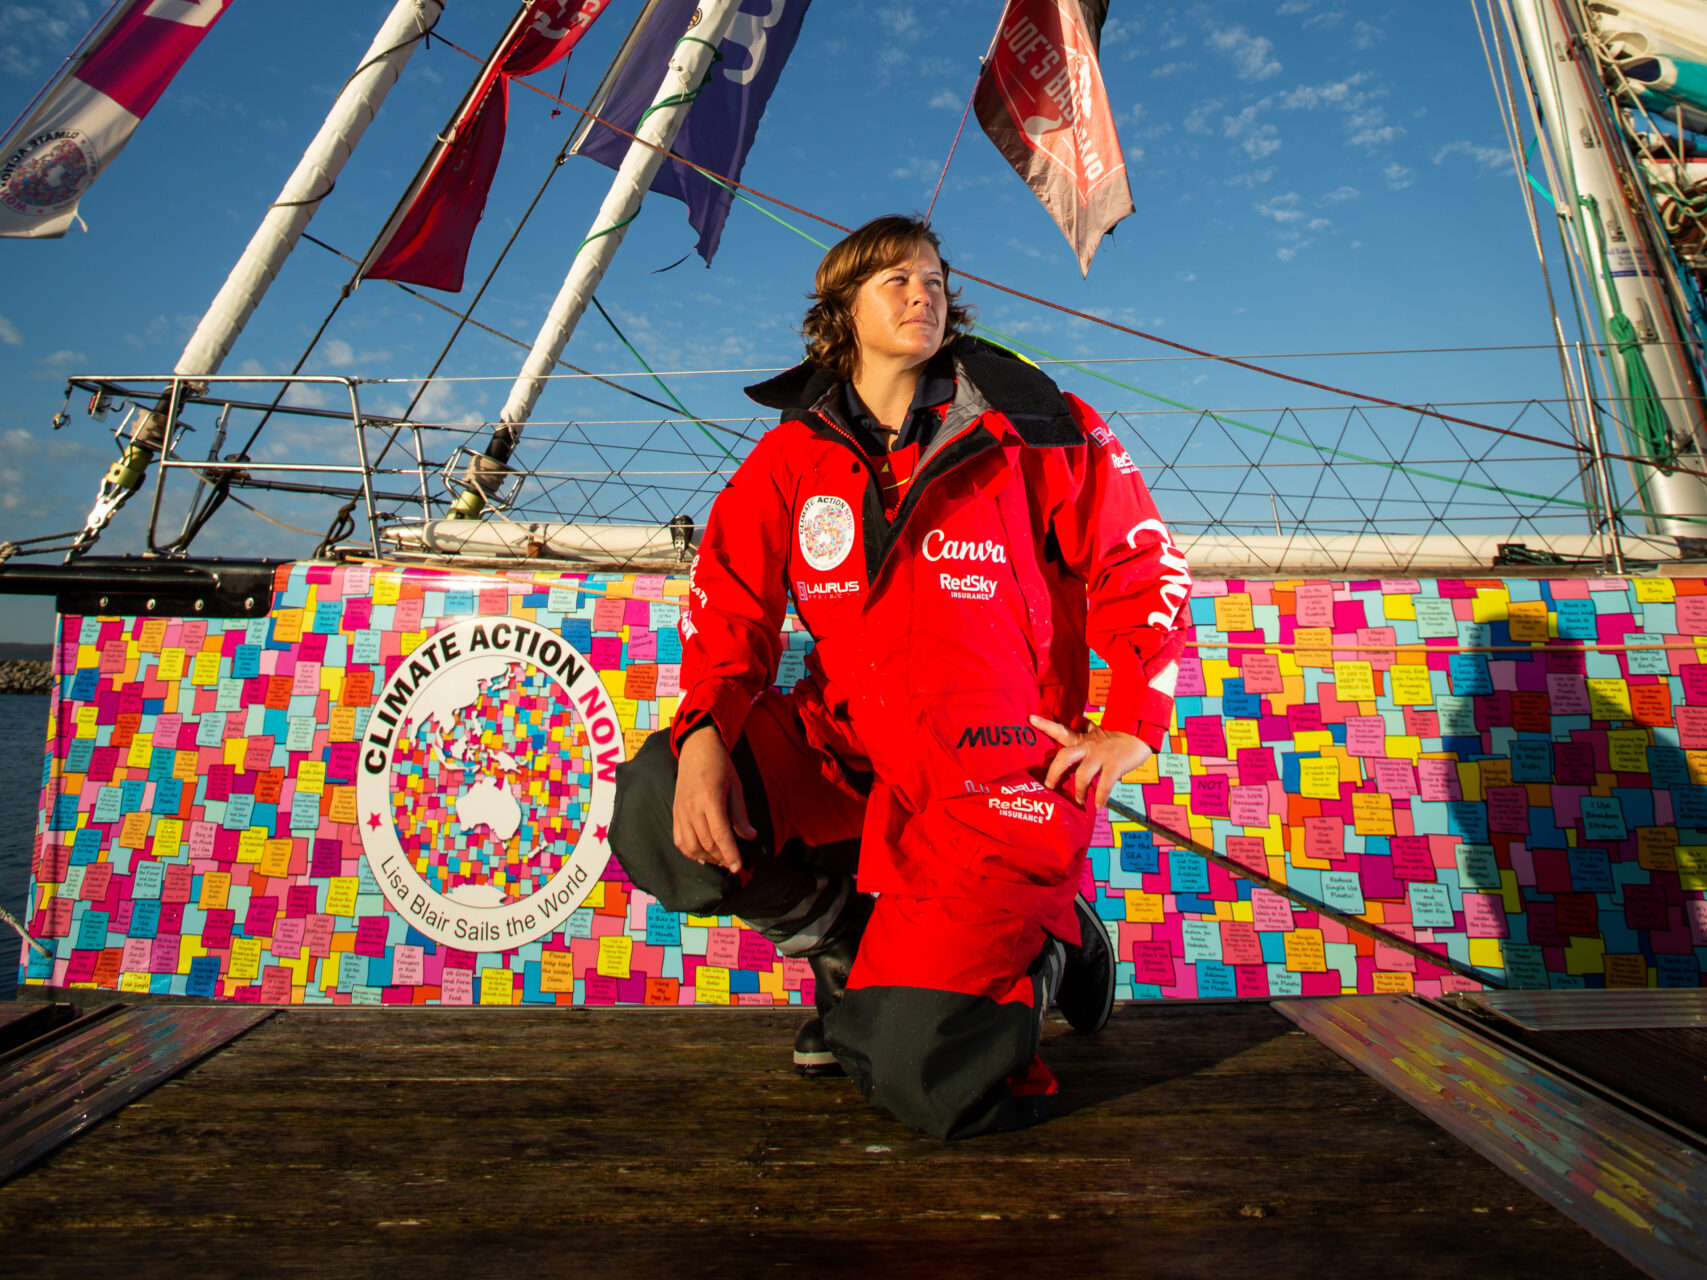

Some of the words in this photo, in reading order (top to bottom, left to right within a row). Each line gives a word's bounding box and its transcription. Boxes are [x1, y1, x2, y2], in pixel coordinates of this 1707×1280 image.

[1002, 16, 1061, 80] JOE'S
[817, 497, 845, 509] ACTION
[922, 529, 1006, 563] Canva
[806, 581, 860, 594] LAURUS
[939, 573, 998, 598] RedSky
[950, 591, 989, 601] INSURANCE
[365, 632, 461, 775] CLIMATE
[469, 624, 585, 688] ACTION
[578, 685, 619, 784] NOW
[956, 725, 1036, 749] MUSTO
[1198, 780, 1223, 790] NOT
[988, 796, 1055, 821] RedSky
[999, 809, 1044, 824] INSURANCE
[381, 855, 410, 900] Lisa
[409, 893, 450, 932] Blair
[454, 918, 500, 941] Sails
[506, 908, 537, 938] the
[537, 864, 588, 919] World
